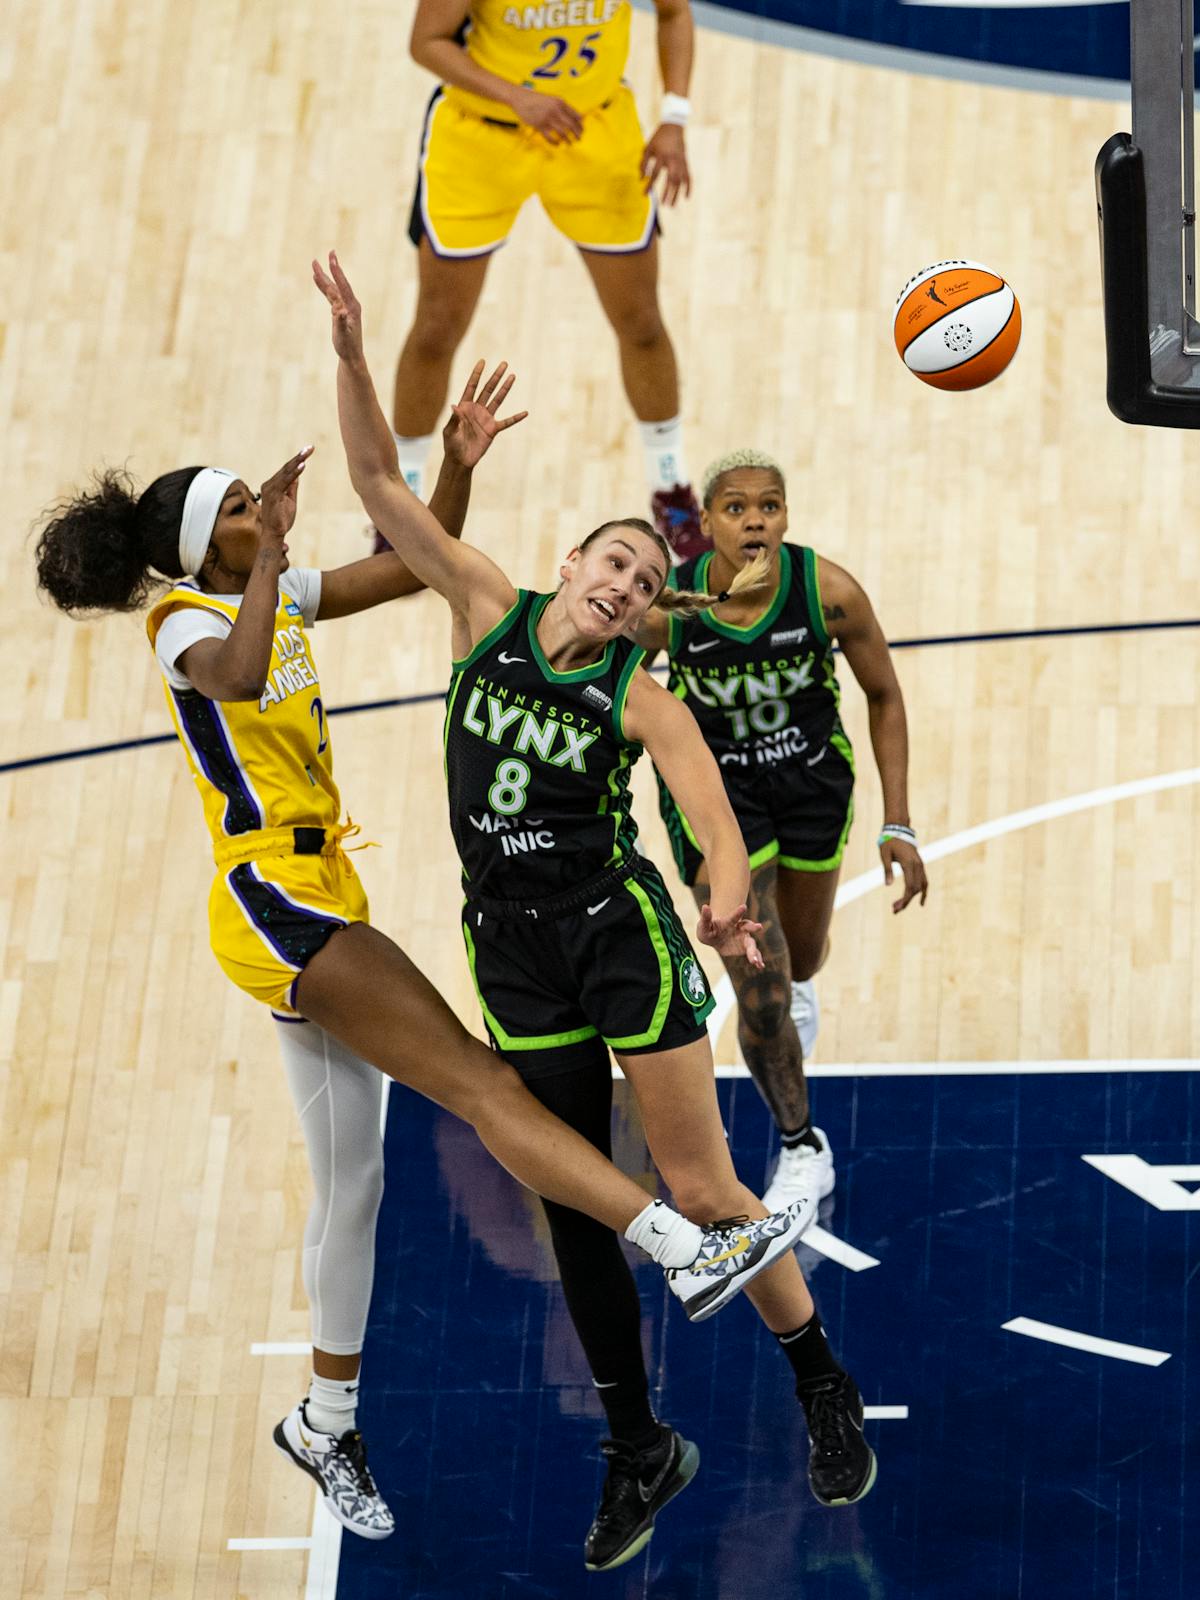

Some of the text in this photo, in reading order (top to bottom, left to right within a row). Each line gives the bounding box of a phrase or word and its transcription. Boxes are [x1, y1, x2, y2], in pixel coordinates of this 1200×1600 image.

[532, 32, 602, 78] 25
[476, 675, 602, 736] MINNESOTA
[684, 660, 816, 708] LYNX
[463, 687, 600, 773] LYNX
[724, 698, 790, 741] 10
[488, 758, 531, 816] 8
[501, 830, 556, 856] INIC
